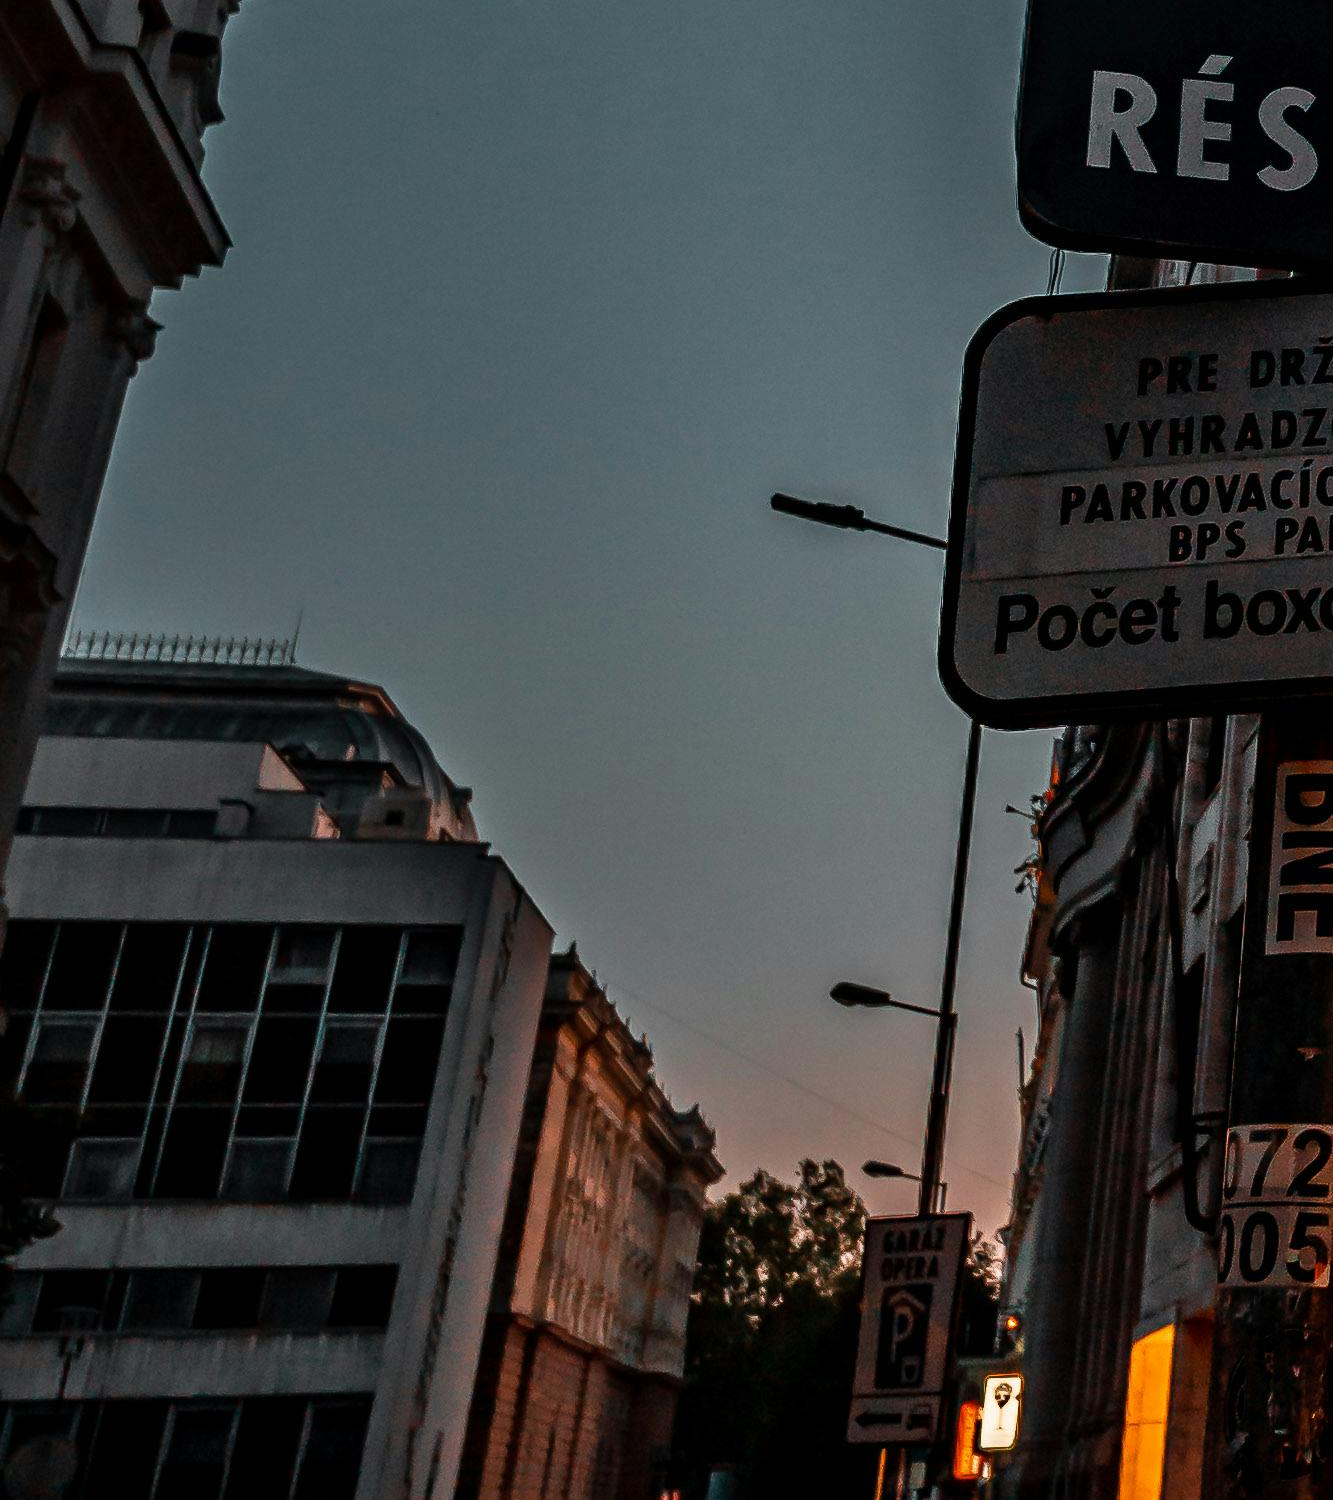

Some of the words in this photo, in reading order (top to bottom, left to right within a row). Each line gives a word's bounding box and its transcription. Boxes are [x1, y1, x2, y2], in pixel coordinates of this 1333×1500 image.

[1137, 353, 1219, 396] PRE
[1168, 520, 1246, 562] BPS
[994, 585, 1182, 655] Počet
